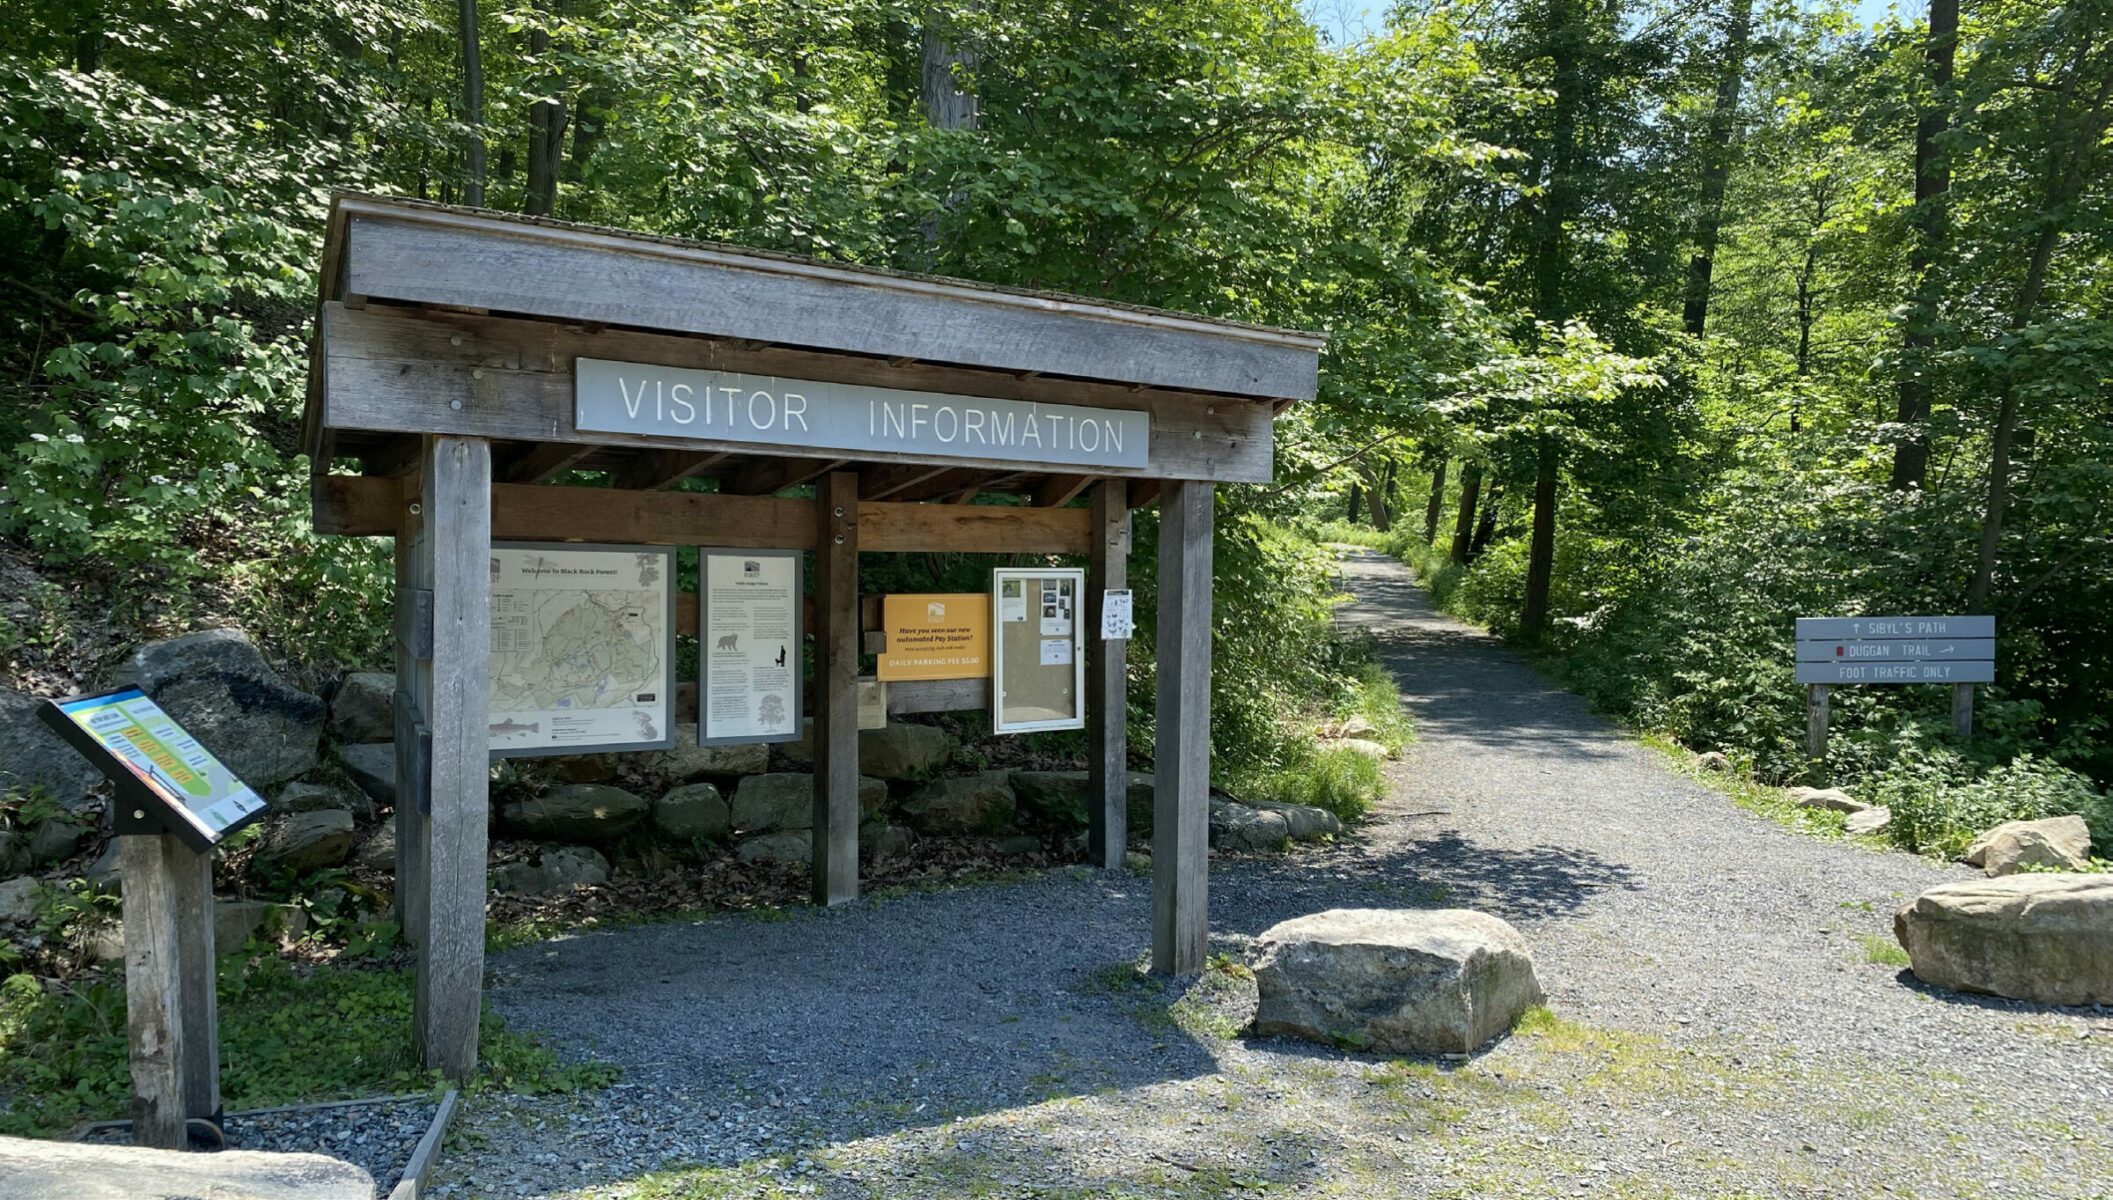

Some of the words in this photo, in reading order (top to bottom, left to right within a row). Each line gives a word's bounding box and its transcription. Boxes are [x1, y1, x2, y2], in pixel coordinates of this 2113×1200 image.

[617, 376, 809, 433] VISITOR
[869, 398, 1124, 454] INFORMATION
[1868, 622, 1912, 635] SIBYL'S
[1918, 621, 1946, 634] PATH
[896, 635, 934, 643] automated
[1849, 645, 1890, 657] DUGGAN
[1902, 644, 1931, 656] TRAIL
[889, 659, 912, 667] DAILY
[913, 658, 946, 666] PARKING
[948, 657, 960, 665] FEE
[1839, 666, 1866, 679] FOOT
[1874, 666, 1918, 679] TRAFFIC
[1923, 666, 1951, 678] ONLY
